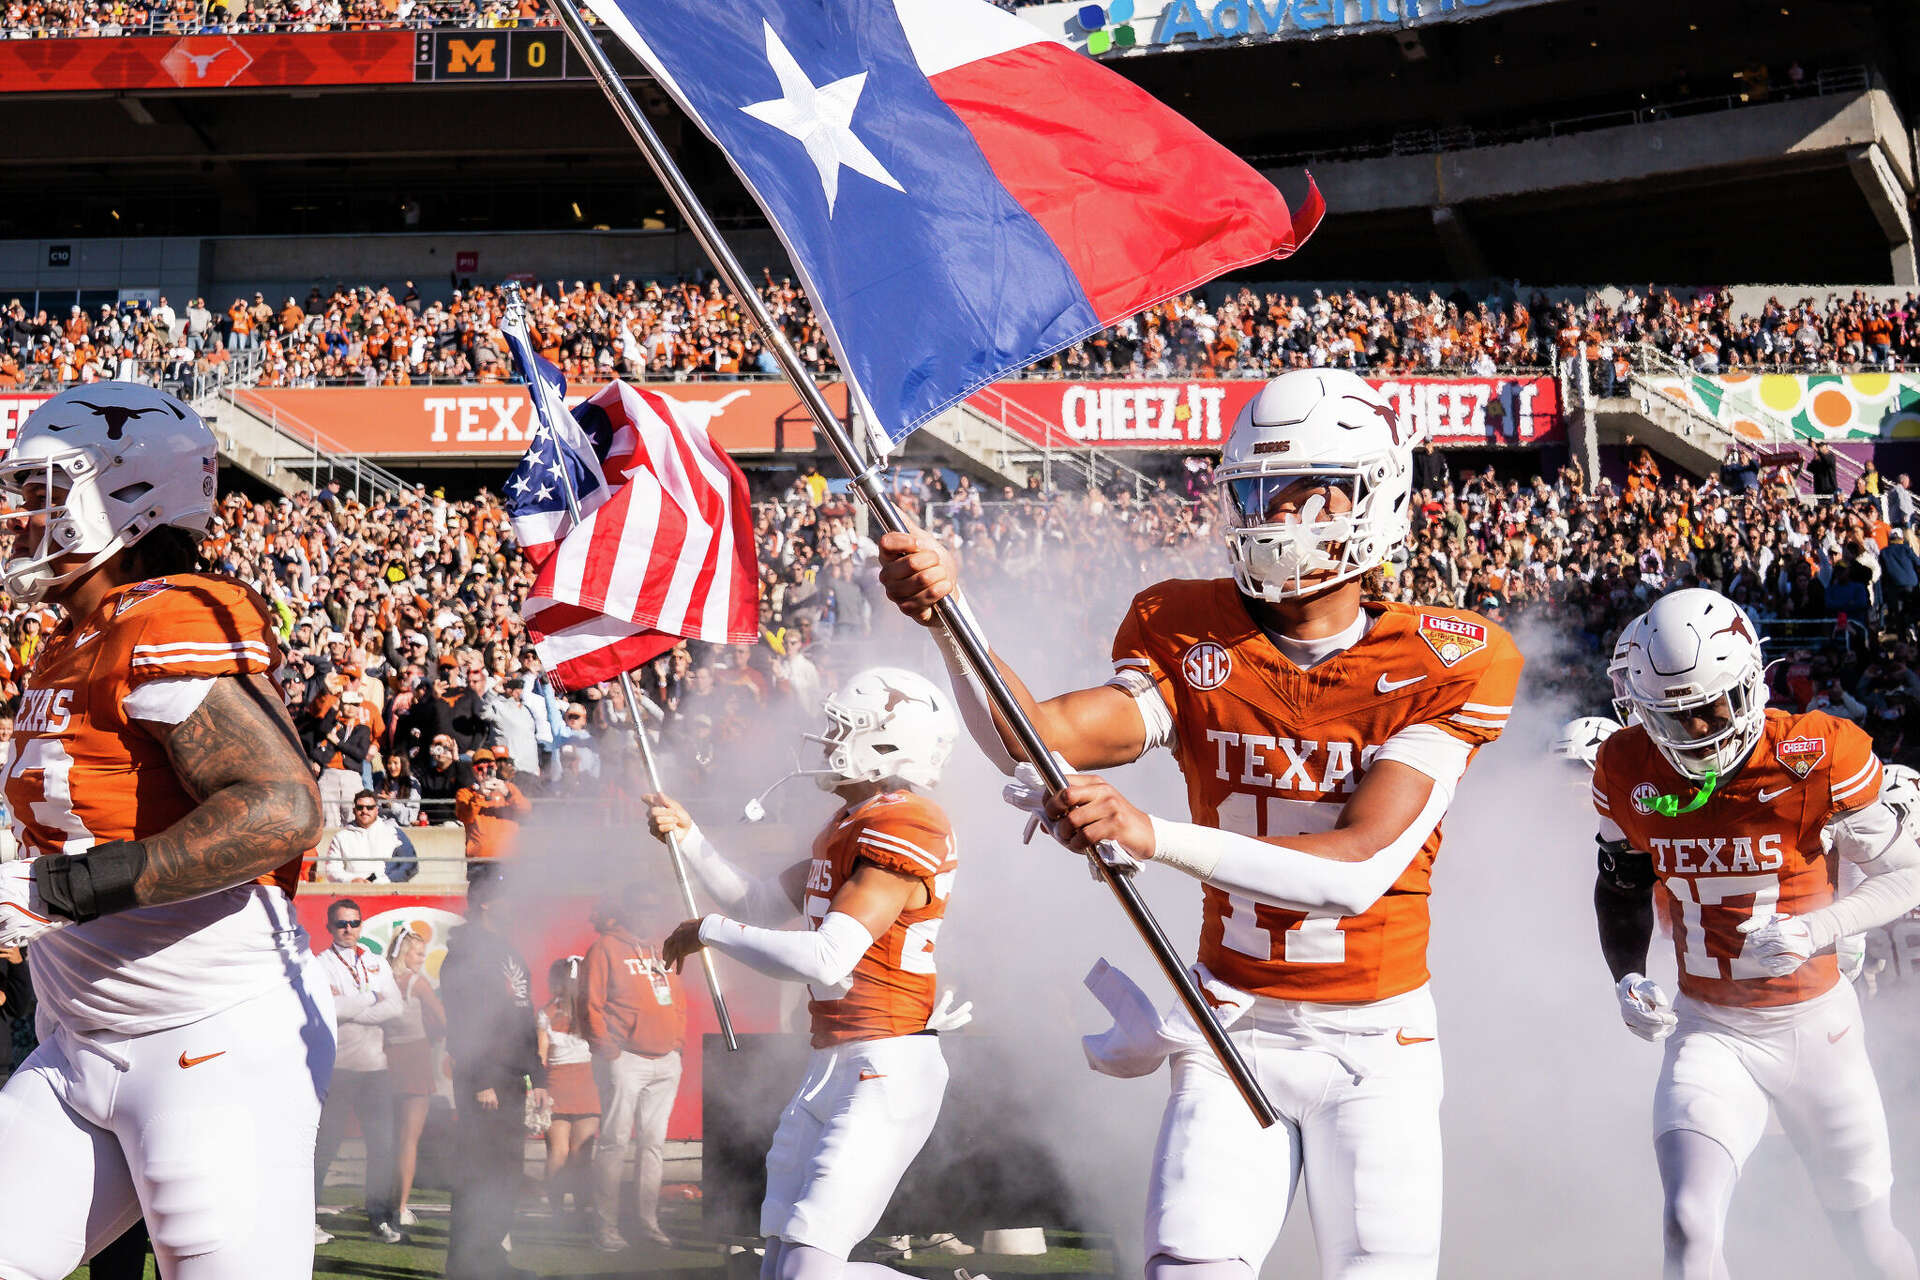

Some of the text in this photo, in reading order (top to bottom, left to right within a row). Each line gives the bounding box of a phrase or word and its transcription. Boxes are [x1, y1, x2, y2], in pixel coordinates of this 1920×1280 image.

[447, 39, 496, 72] M
[527, 41, 546, 67] 0
[1187, 645, 1227, 687] SEC
[1649, 834, 1784, 873] TEXAS
[1665, 873, 1781, 980] 17
